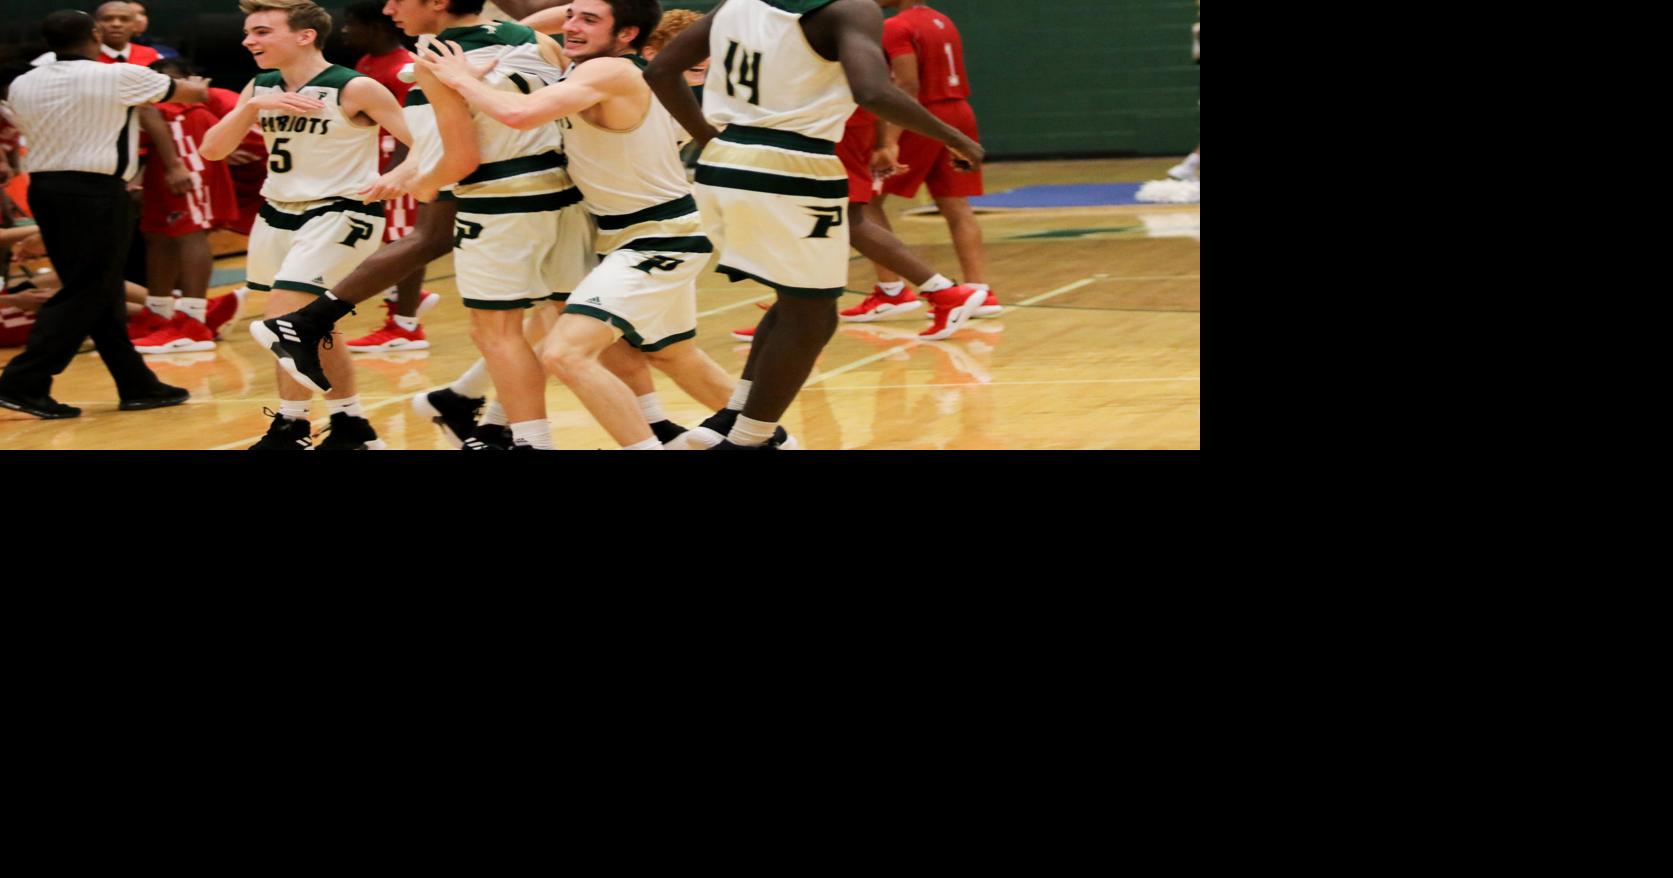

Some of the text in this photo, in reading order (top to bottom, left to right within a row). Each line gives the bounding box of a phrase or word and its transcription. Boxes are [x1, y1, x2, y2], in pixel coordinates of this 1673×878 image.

[723, 39, 762, 106] 14
[944, 42, 960, 87] 1
[270, 137, 292, 174] 5
